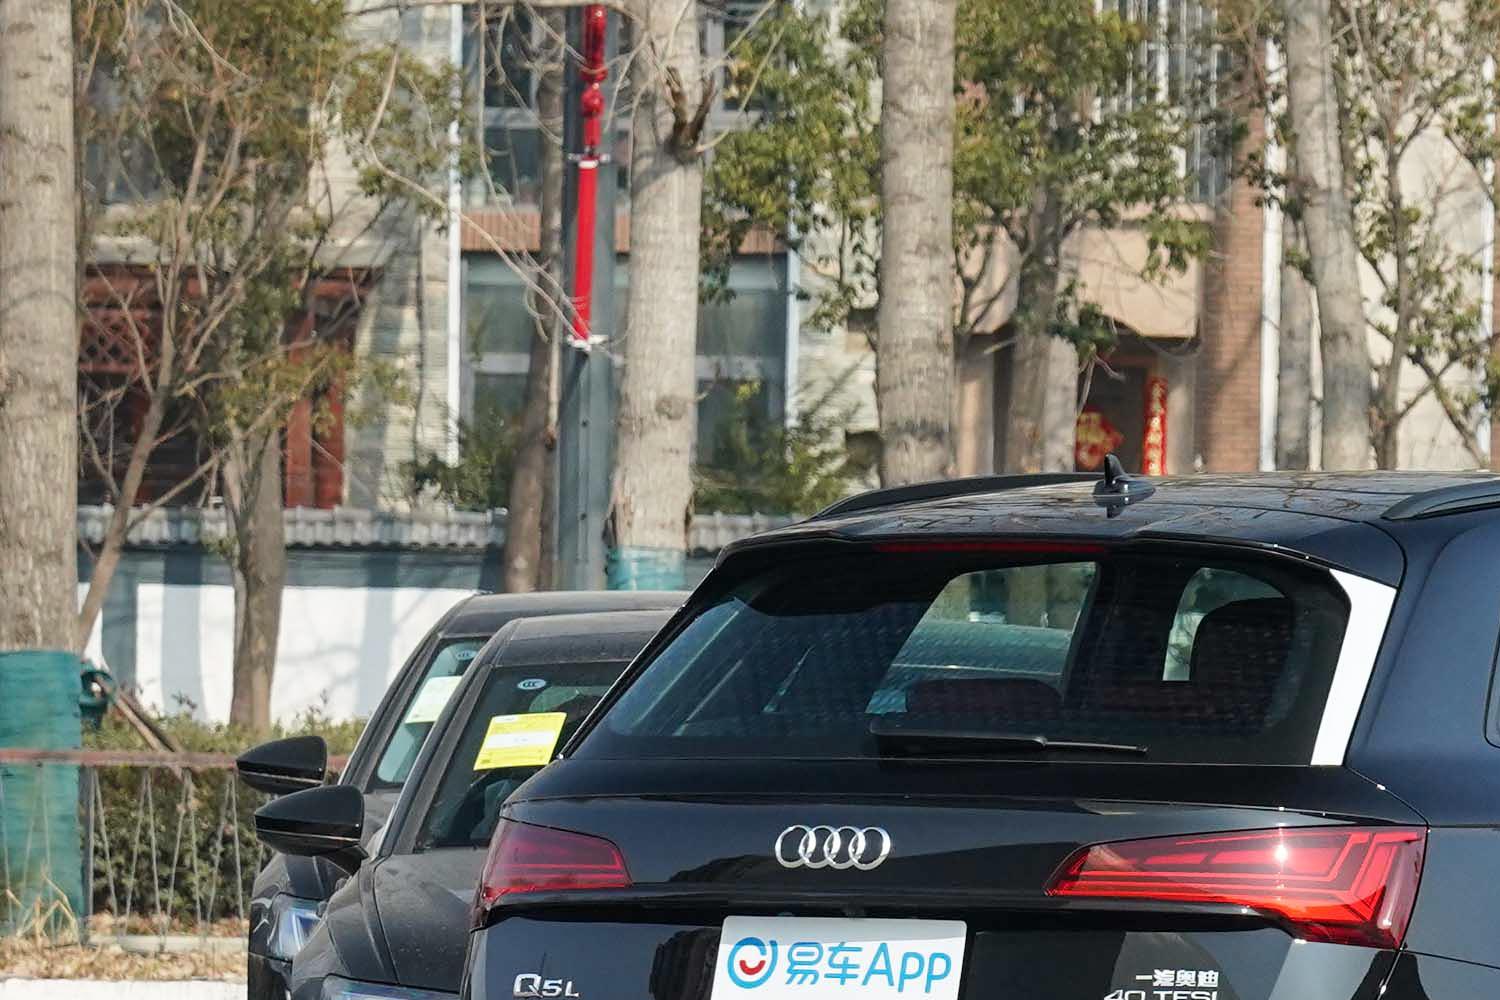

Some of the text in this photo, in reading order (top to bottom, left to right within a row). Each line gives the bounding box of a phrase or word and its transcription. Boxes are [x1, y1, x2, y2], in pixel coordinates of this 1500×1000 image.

[785, 941, 952, 993] 易车App
[1135, 968, 1219, 988] 一汽奥迪
[513, 973, 580, 999] Q5L
